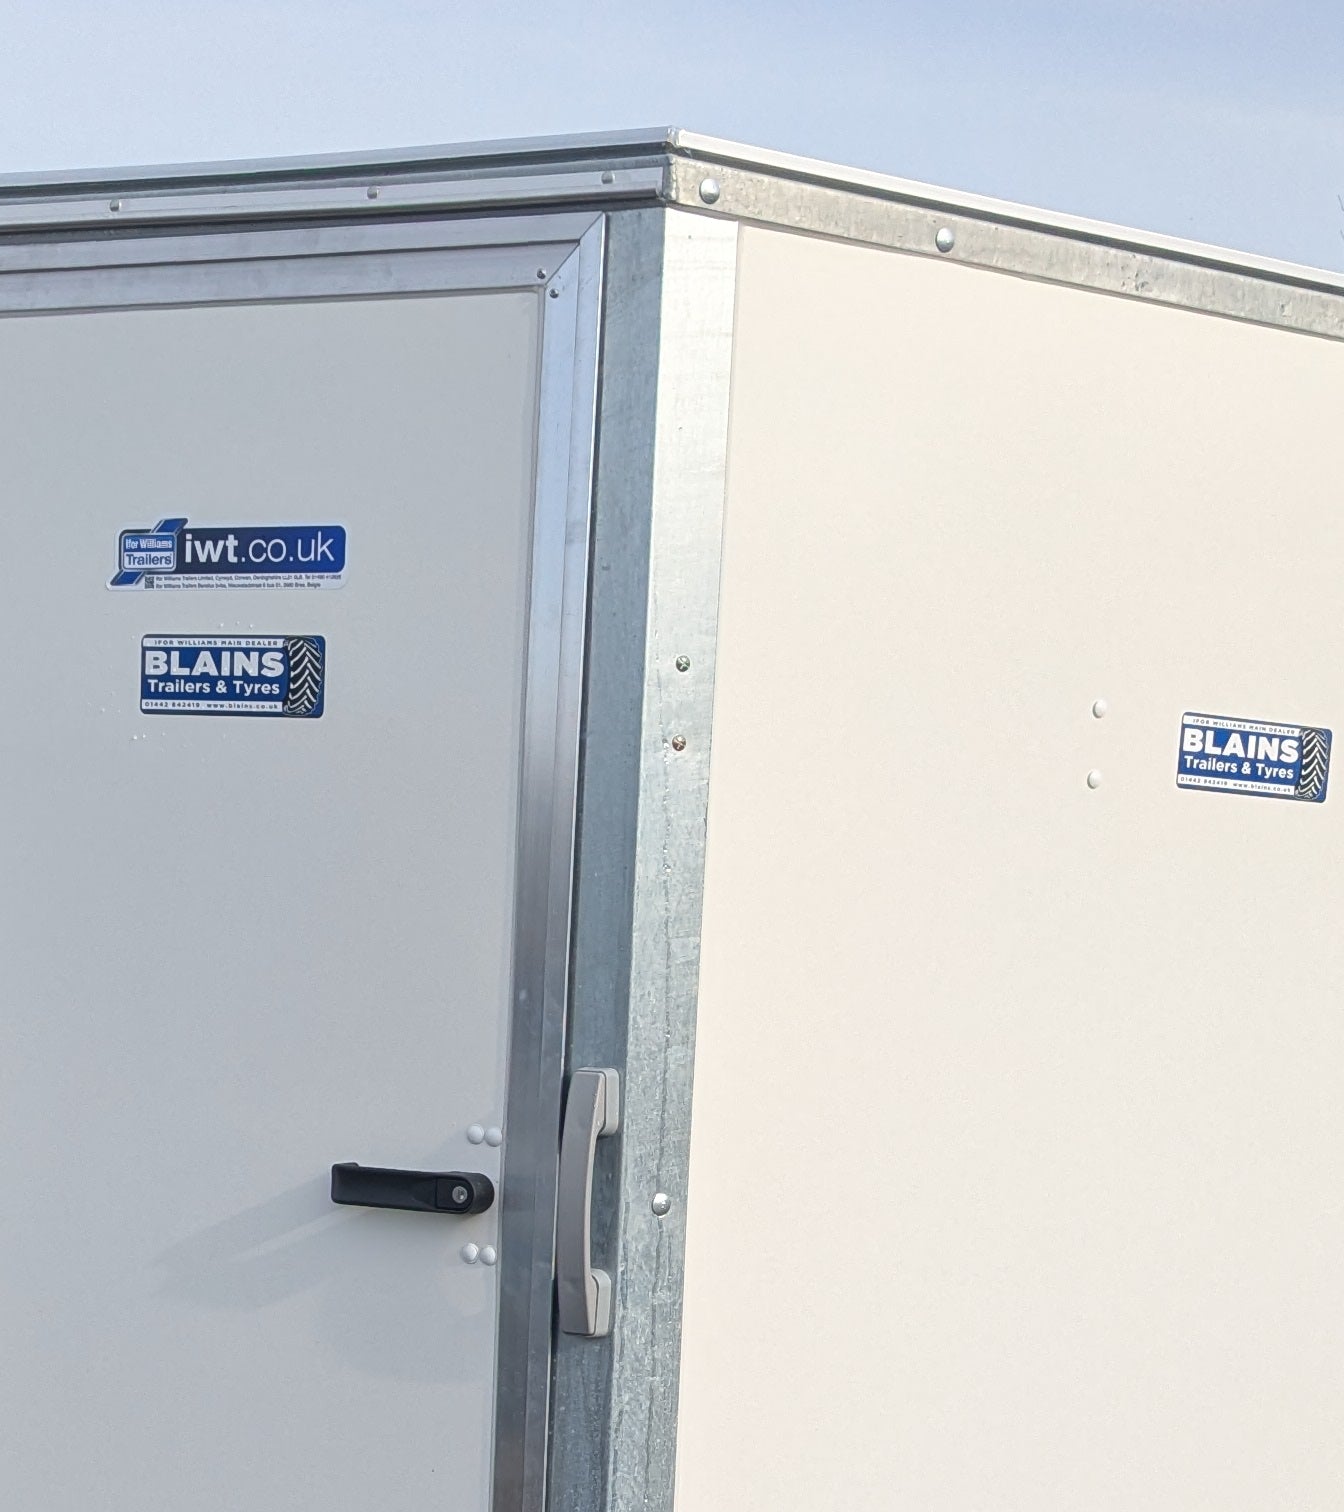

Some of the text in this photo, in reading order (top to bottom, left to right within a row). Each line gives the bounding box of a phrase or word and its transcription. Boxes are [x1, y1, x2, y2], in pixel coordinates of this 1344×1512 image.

[140, 538, 173, 549] Williams
[184, 531, 335, 563] iwt.co.uk
[126, 554, 172, 566] Trailers
[145, 650, 284, 677] BLAINS
[147, 679, 280, 697] Trailers & Tyres
[1213, 720, 1247, 730] WILLIAMS
[1183, 727, 1299, 763] BLAINS
[1184, 755, 1294, 779] Trailers & Tyres
